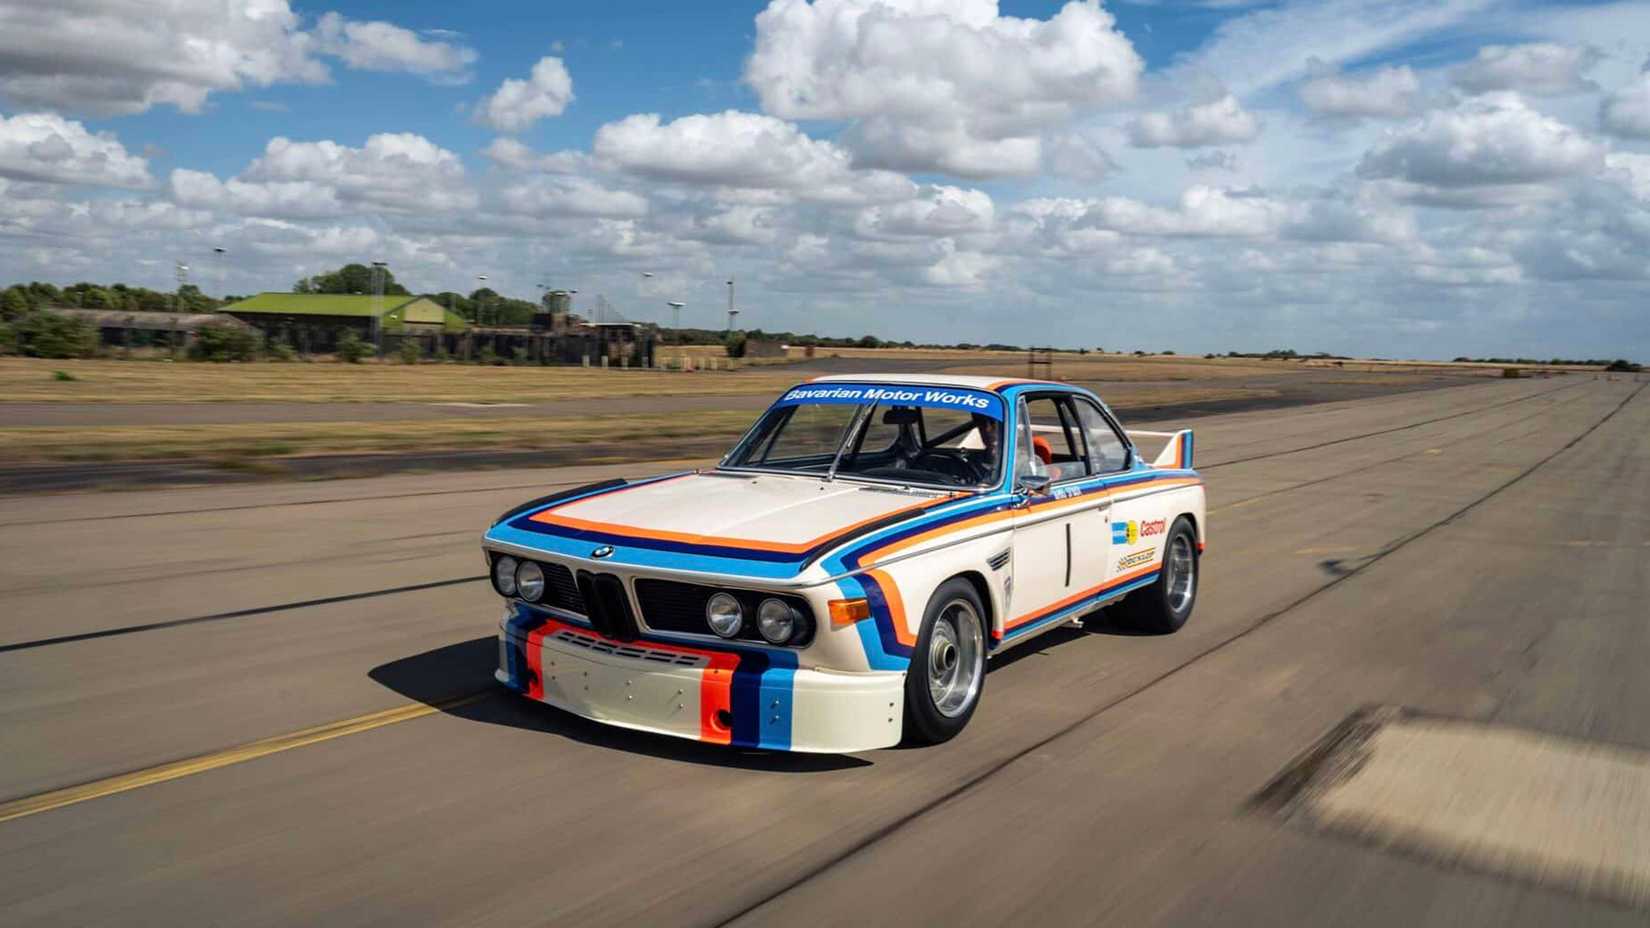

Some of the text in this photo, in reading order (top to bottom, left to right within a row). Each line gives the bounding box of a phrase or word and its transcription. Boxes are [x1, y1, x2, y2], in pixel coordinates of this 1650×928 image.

[784, 388, 990, 409] Bavarian Motor Works
